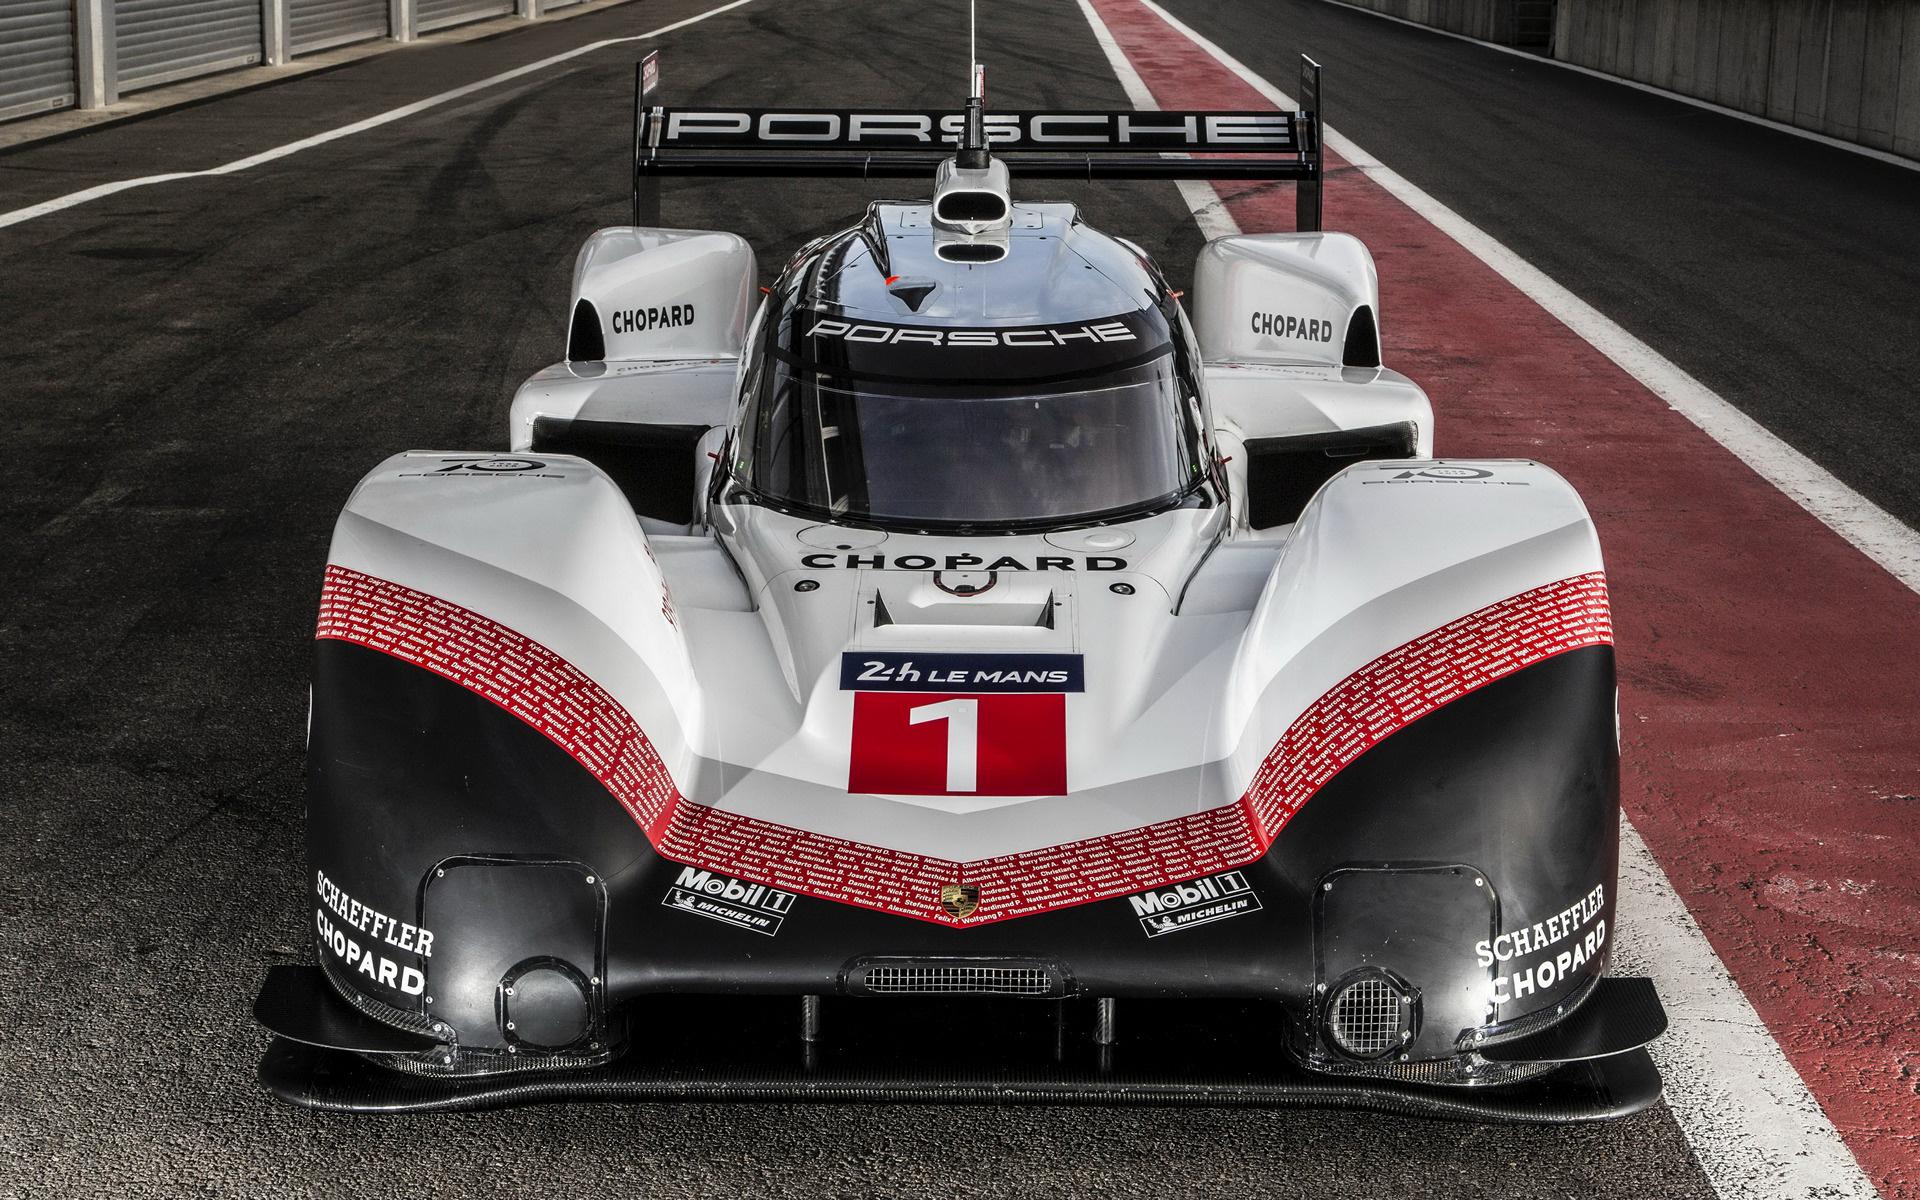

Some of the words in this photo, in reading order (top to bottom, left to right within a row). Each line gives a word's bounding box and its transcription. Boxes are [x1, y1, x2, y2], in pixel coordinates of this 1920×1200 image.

[667, 112, 1291, 144] PORSCHE
[612, 303, 695, 334] CHOPARD
[1251, 311, 1332, 343] CHOPARD
[805, 319, 1137, 347] PORSCHE
[801, 554, 1128, 571] CHOPARD
[928, 670, 968, 683] LE
[973, 671, 1068, 684] MANS
[909, 699, 979, 793] 1
[703, 822, 721, 831] Luigi
[730, 830, 754, 839] Marcel
[706, 816, 726, 825] Andre
[736, 824, 760, 833] Imanol
[759, 829, 785, 839] Leizabe
[711, 810, 738, 821] Christos
[749, 820, 798, 835] Bernd-Michael
[1110, 830, 1140, 839] Veronika
[1149, 821, 1178, 831] Stephan
[1154, 829, 1177, 837] Martin
[700, 836, 732, 849] Korbinian
[745, 848, 771, 859] Sabrina
[712, 832, 739, 843] Luciano
[759, 844, 786, 854] Michele
[1148, 836, 1179, 846] Christian
[1183, 837, 1203, 845] Jonah
[697, 851, 721, 861] Dennis
[731, 860, 761, 872] Emiliano
[704, 845, 728, 856] Florian
[766, 861, 794, 872] Dietrich
[924, 858, 952, 867] Michael
[1018, 850, 1048, 859] Stefanie
[1125, 856, 1152, 866] Michael
[708, 862, 733, 873] Markus
[743, 871, 765, 881] Tobias
[775, 879, 803, 890] Michael
[861, 859, 878, 867] Luca
[917, 871, 949, 882] Matthias
[962, 874, 992, 884] Albrecht
[1032, 863, 1050, 871] Josef
[1040, 867, 1072, 876] Christian
[1081, 859, 1104, 868] Harald
[1122, 865, 1153, 875] Ruediger
[1165, 856, 1187, 865] Albert
[1165, 865, 1184, 873] Chris
[1168, 871, 1192, 880] Pascal
[675, 866, 766, 906] Mobil
[848, 879, 875, 890] Damien
[887, 888, 904, 896] Nick
[878, 878, 900, 887] André
[981, 887, 1010, 896] Andreas
[1021, 880, 1043, 888] Bernd
[1022, 888, 1043, 896] Klaus
[1053, 881, 1078, 889] Tomas
[1089, 873, 1112, 882] Daniel
[807, 878, 832, 888] Robert
[841, 886, 865, 895] Olivier
[904, 899, 935, 910] Stefanie
[1026, 891, 1062, 903] Nathanael
[1128, 878, 1220, 917] Mobil
[316, 869, 435, 958] SCHAEFFLER
[696, 901, 771, 927] MICHELIN
[853, 896, 876, 906] Reiner
[887, 904, 923, 916] Alexander
[1008, 906, 1037, 915] Thomas
[1049, 896, 1083, 907] Alexander
[1177, 899, 1248, 924] MICHELIN
[1474, 883, 1605, 968] SCHAEFFLER
[316, 908, 426, 996] CHOPARD
[1487, 919, 1606, 1005] CHOPARD
